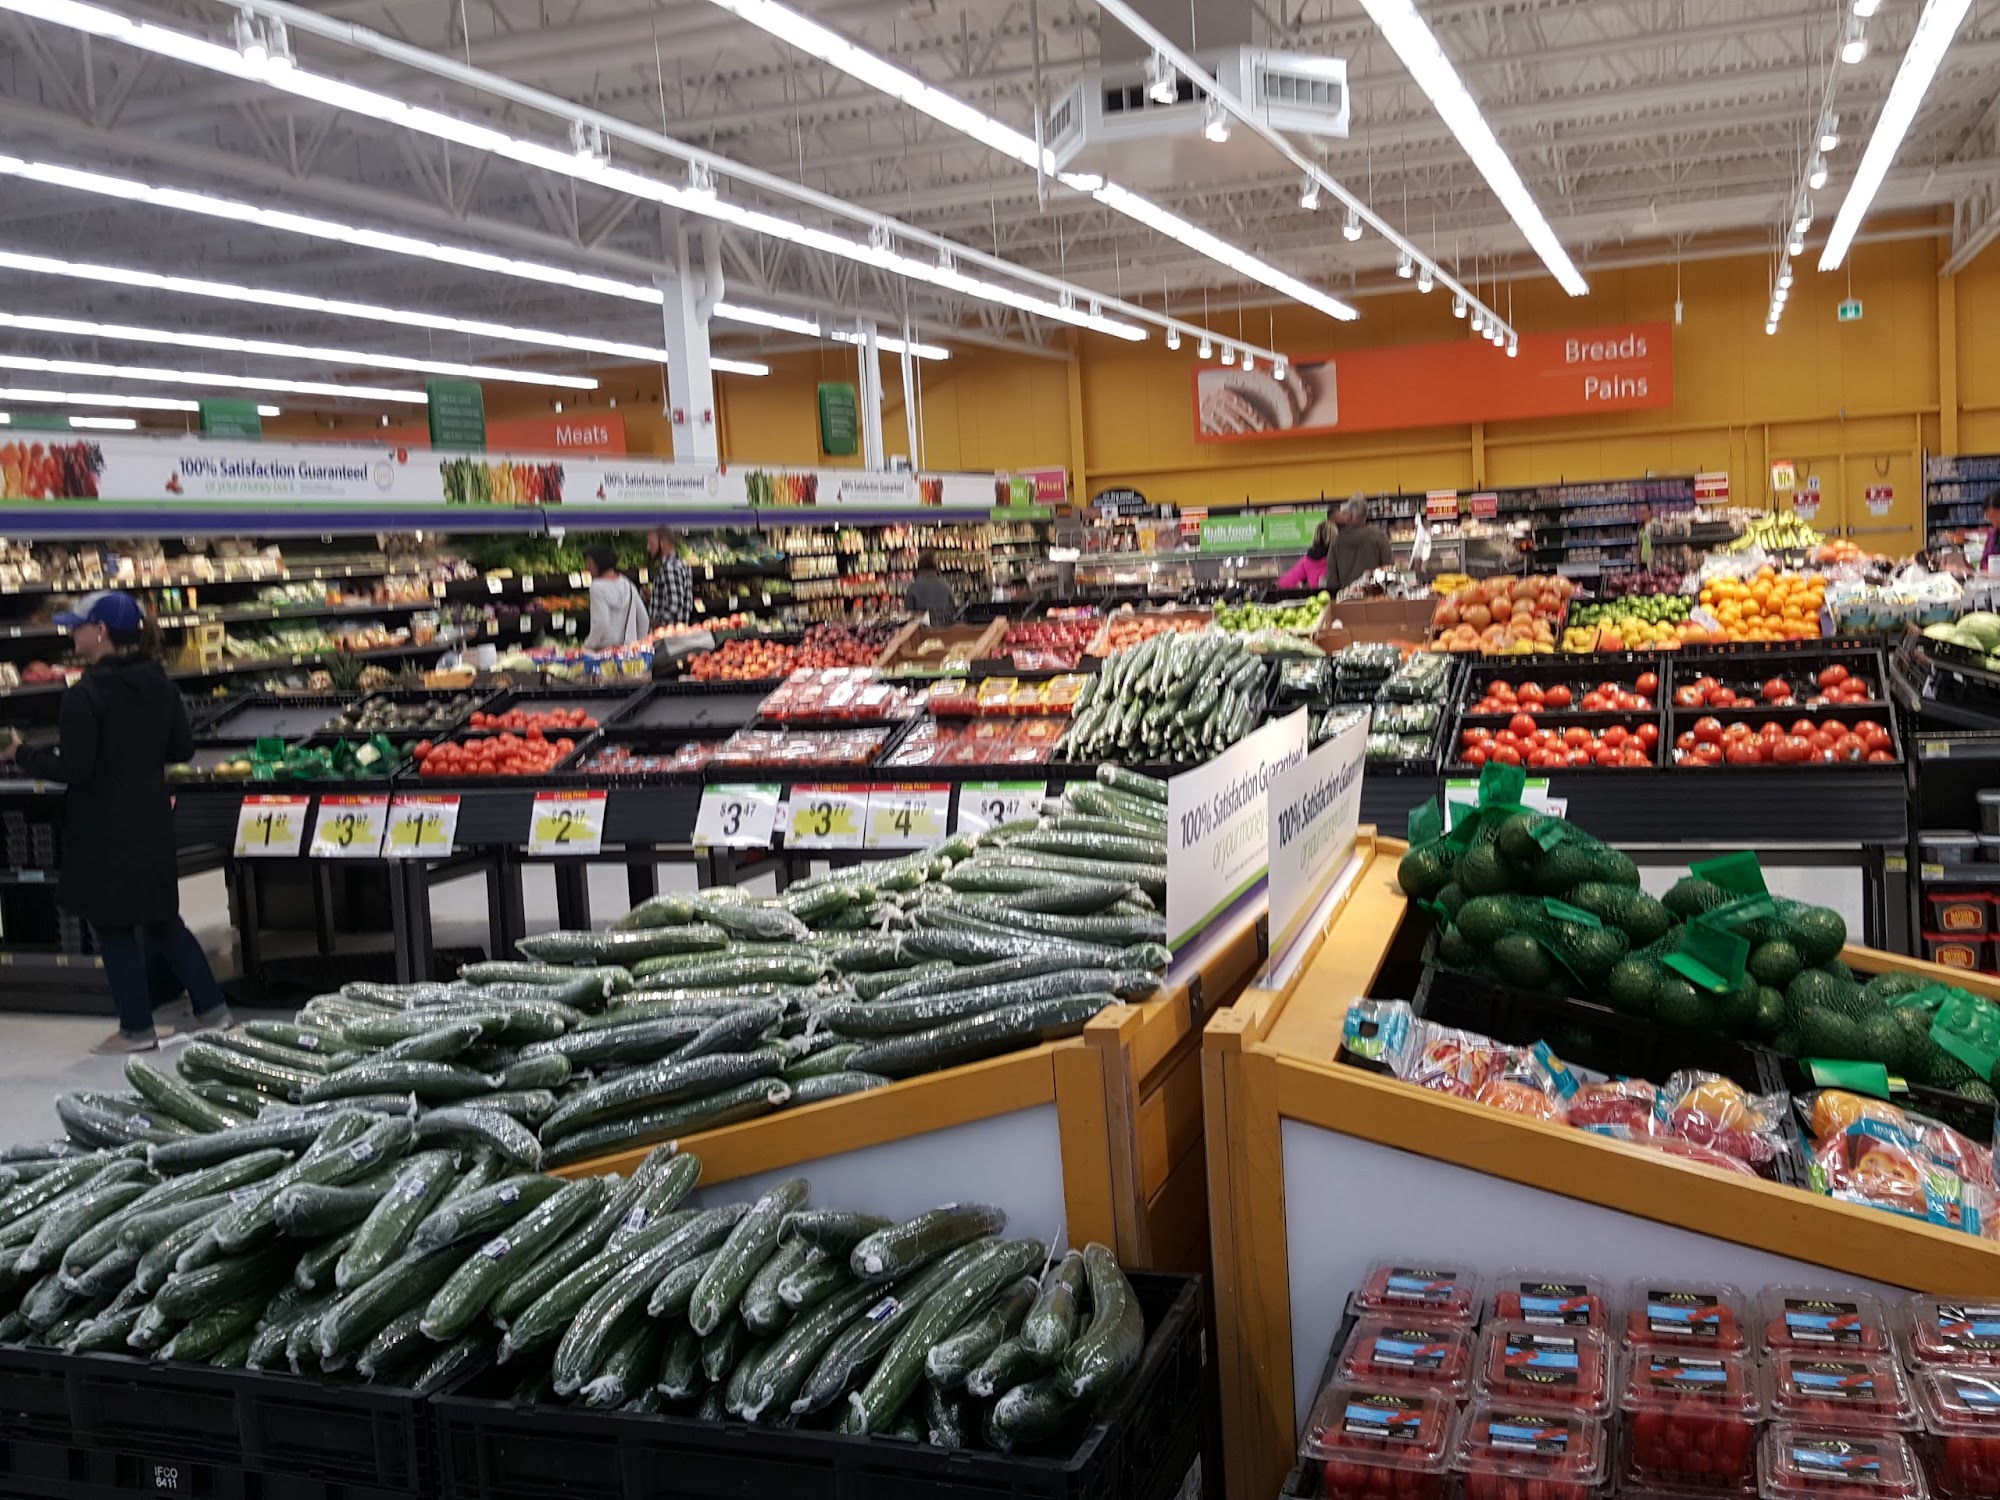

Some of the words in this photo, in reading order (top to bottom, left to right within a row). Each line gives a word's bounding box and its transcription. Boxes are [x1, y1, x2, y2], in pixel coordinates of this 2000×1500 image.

[1565, 332, 1647, 363] Breads
[1585, 373, 1648, 401] Pains
[556, 424, 608, 447] Meats
[179, 457, 217, 477] 100%
[220, 458, 295, 479] Satisfaction
[299, 461, 368, 482] Guaranteed
[1181, 798, 1212, 850] 100%
[1213, 769, 1258, 831] Satisfaction
[1278, 798, 1301, 850] 100%
[1302, 770, 1340, 831] Satisfaction
[154, 1465, 178, 1479] IFCO
[156, 1476, 177, 1489] 6411
